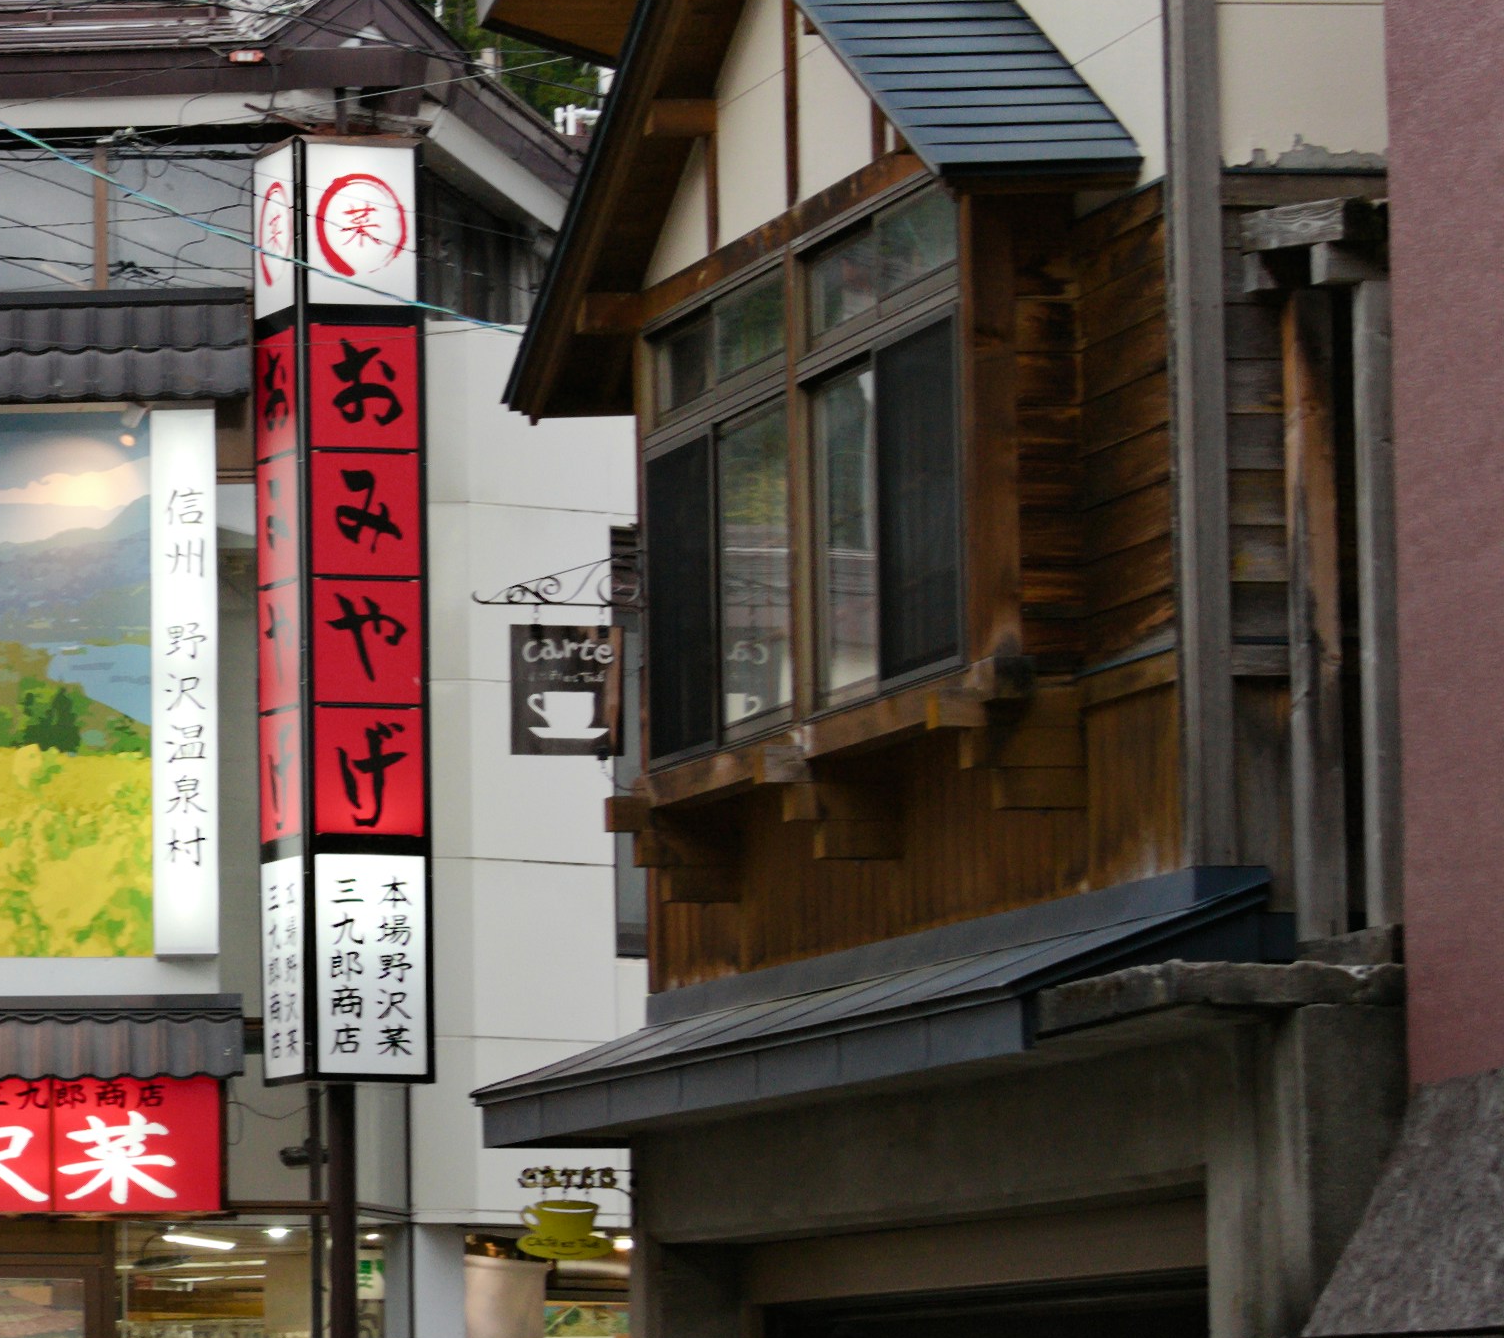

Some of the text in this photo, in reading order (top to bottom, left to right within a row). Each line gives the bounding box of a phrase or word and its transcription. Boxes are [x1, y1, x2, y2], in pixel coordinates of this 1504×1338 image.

[342, 204, 383, 248] 菜
[324, 337, 408, 828] おみやげ
[521, 638, 614, 664] carte
[162, 486, 209, 869] 信州 野沢温泉村
[329, 878, 364, 1055] 三九郎商店
[375, 875, 413, 1057] 本場野沢菜
